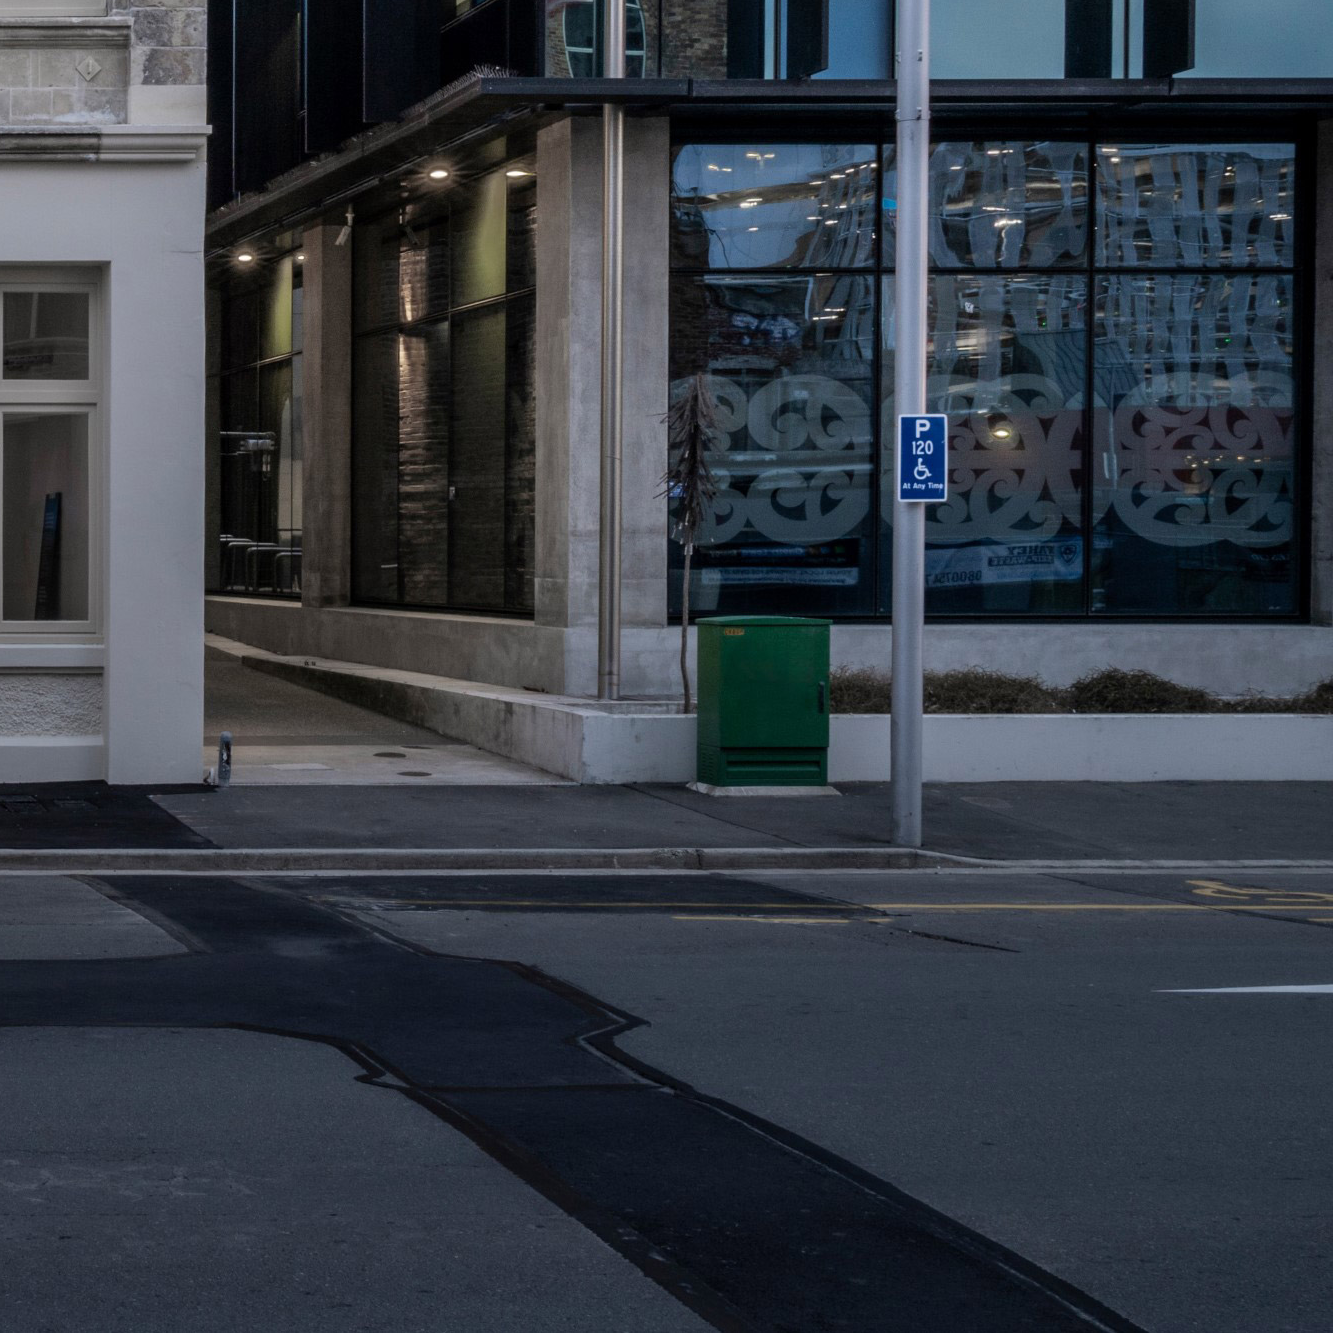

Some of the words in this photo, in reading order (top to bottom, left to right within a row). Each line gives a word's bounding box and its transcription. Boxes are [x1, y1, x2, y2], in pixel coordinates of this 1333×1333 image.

[915, 418, 931, 438] P
[911, 439, 934, 455] 120
[902, 482, 911, 490] At
[913, 482, 926, 491] Any
[927, 482, 944, 490] Time
